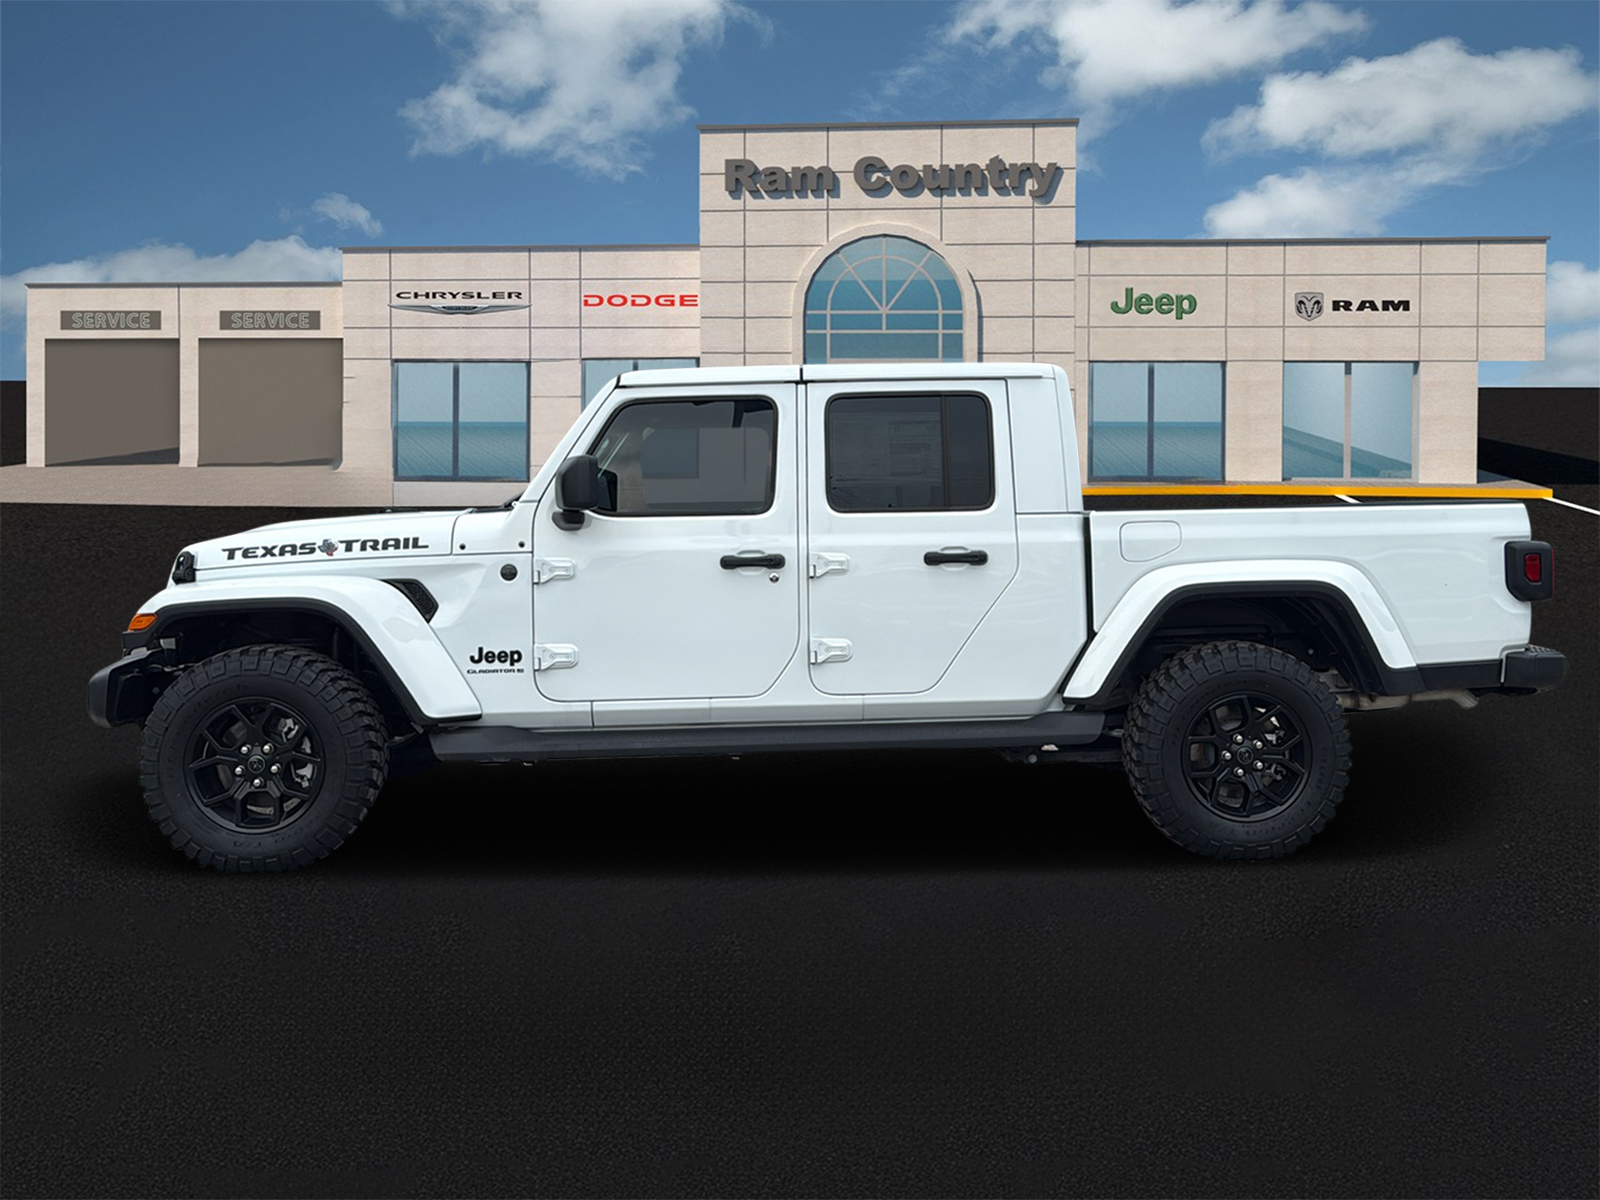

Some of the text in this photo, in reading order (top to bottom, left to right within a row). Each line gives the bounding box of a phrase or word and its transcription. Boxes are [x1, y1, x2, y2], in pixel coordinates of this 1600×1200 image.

[724, 154, 1059, 198] Ram Country
[395, 291, 523, 300] CHRYSLER
[583, 294, 699, 307] DODGE
[1110, 286, 1198, 320] Jeep
[1331, 299, 1411, 312] RAM
[71, 312, 151, 329] SERVICE
[230, 312, 310, 329] SERVICE
[221, 536, 429, 560] TEXAS TRAIL
[469, 646, 523, 667] Jeep
